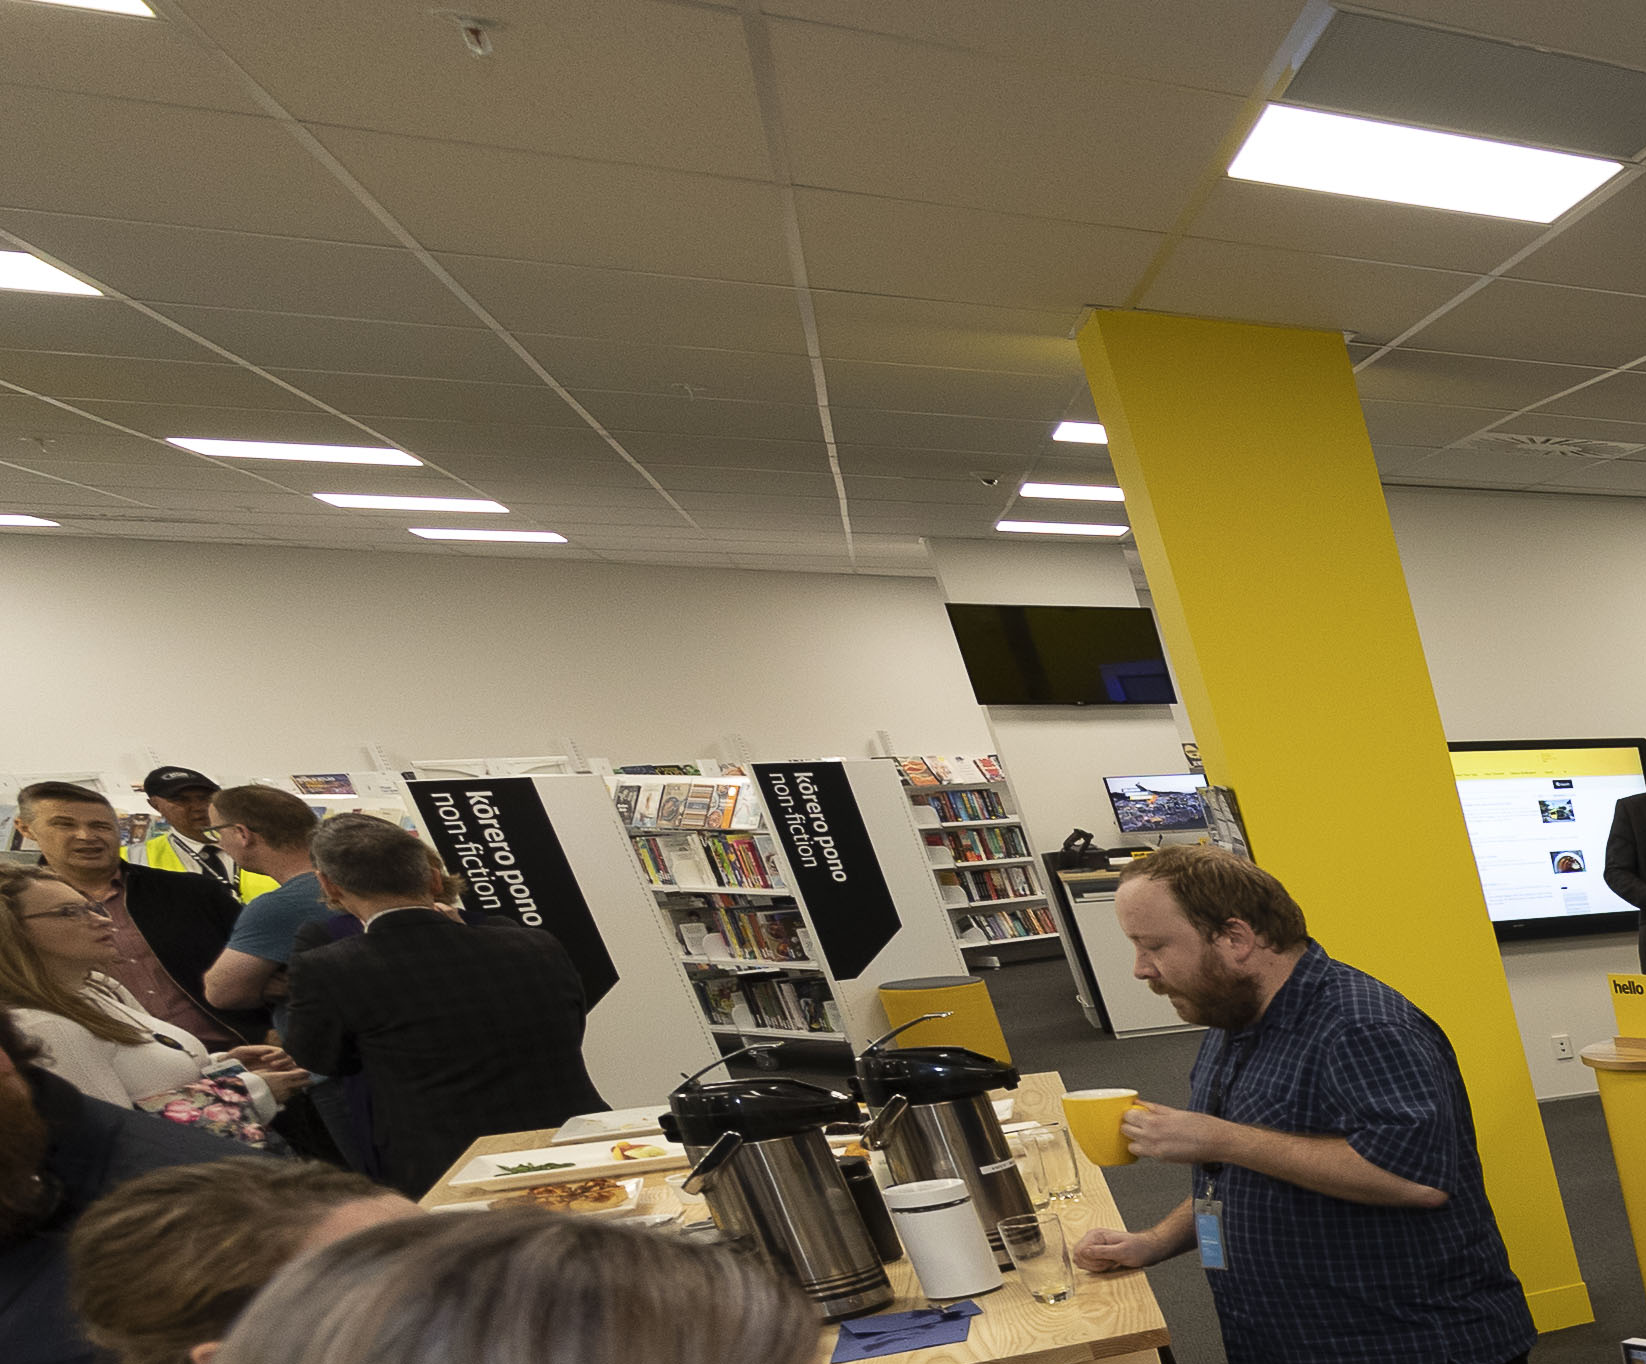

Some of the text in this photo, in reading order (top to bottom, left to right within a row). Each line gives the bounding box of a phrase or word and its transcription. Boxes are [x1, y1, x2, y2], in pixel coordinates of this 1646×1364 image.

[431, 792, 499, 909] non-fiction
[466, 790, 543, 927] kōrero pono
[769, 773, 817, 868] non-fiction
[793, 771, 848, 883] kōrero pono
[1613, 980, 1644, 995] hello
